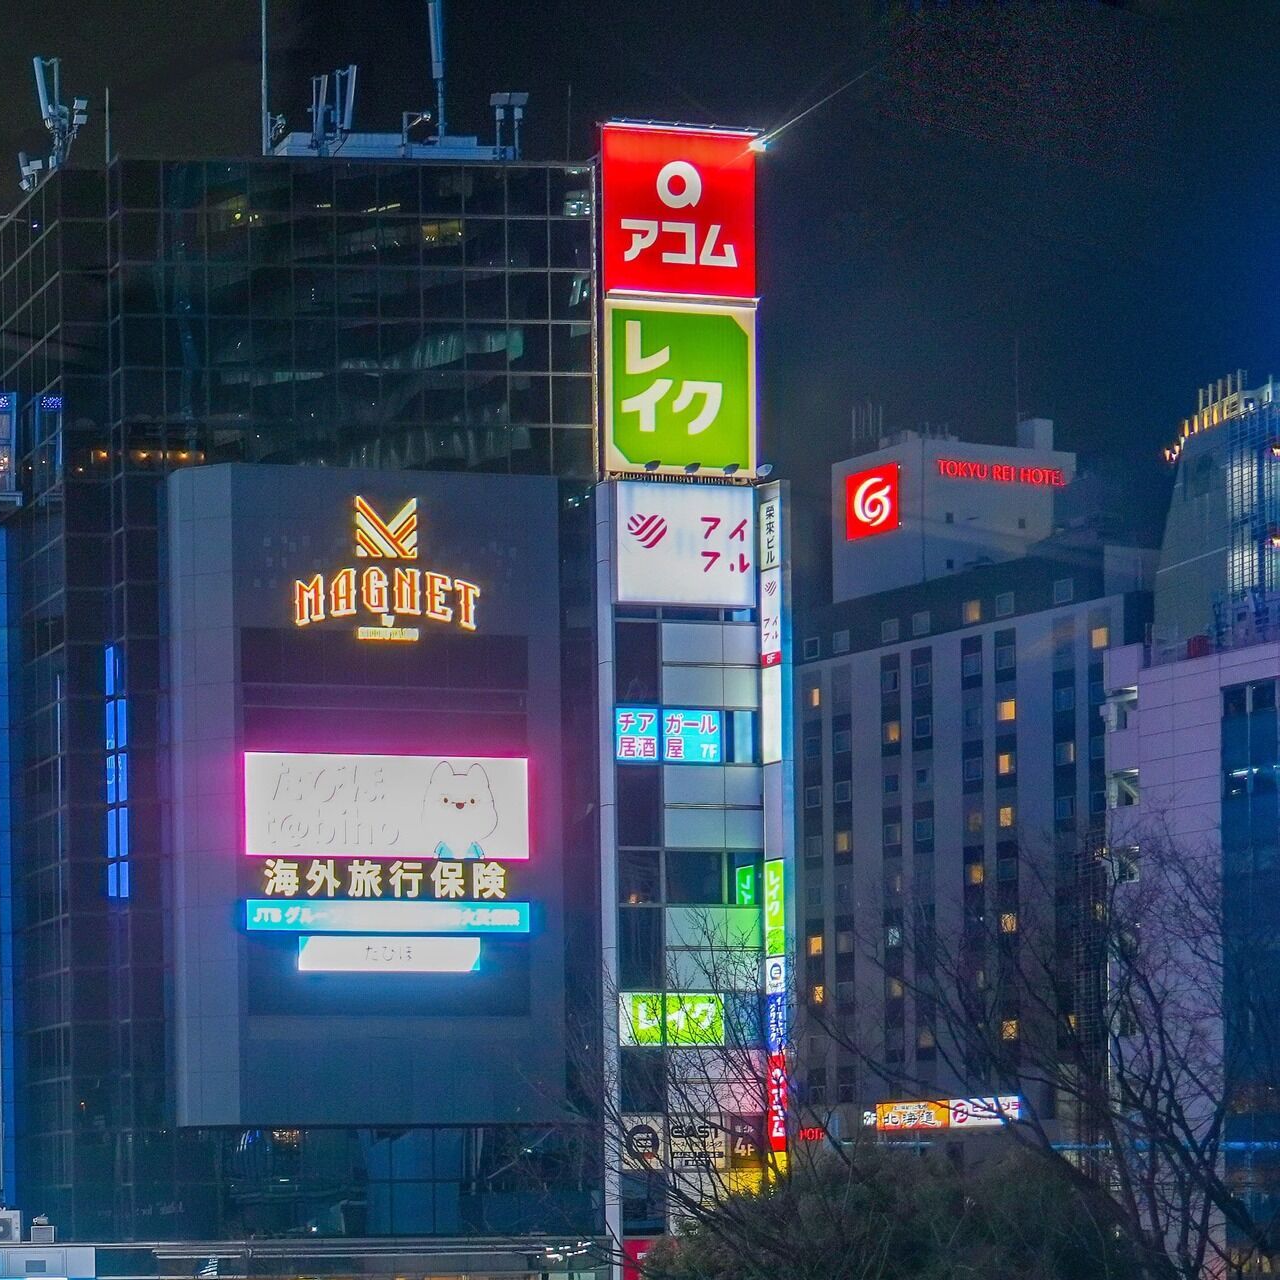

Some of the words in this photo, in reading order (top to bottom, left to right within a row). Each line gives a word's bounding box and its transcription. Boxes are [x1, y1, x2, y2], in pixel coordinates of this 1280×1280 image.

[621, 219, 738, 268] アコム
[938, 459, 986, 482] TOKYU
[992, 464, 1017, 483] REI
[295, 567, 482, 628] MAGNET
[617, 712, 717, 733] チアガール
[618, 736, 684, 759] 居酒屋
[263, 858, 507, 899] 海外旅行保険
